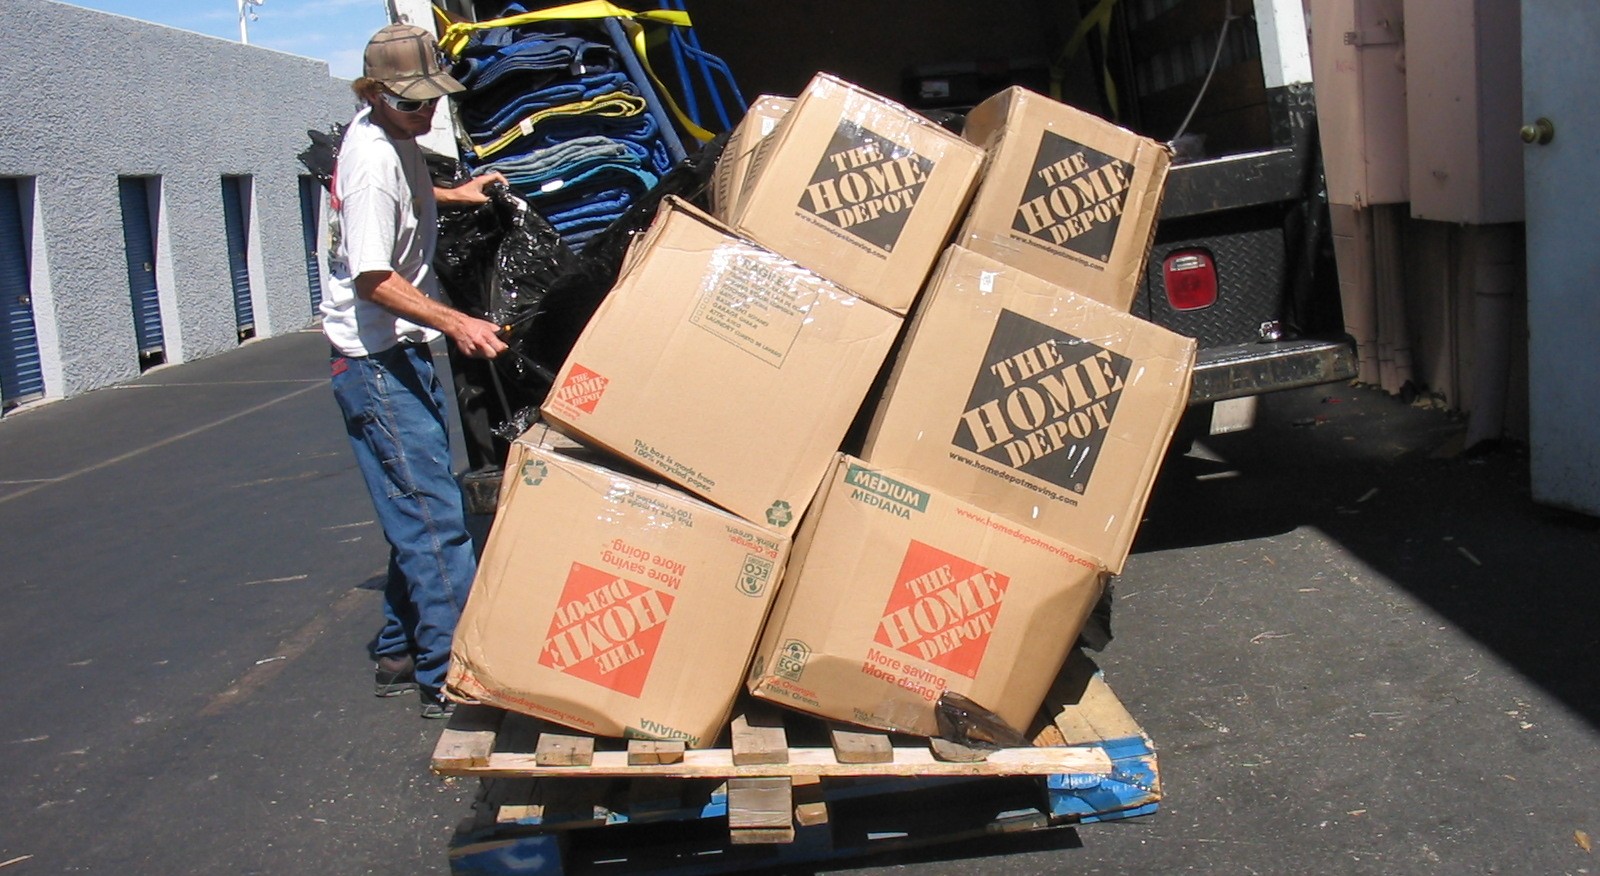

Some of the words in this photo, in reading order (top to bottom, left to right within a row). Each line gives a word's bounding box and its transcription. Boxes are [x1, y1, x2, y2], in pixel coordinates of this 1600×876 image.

[830, 142, 884, 172] THE
[1038, 151, 1089, 187] THE
[807, 154, 927, 215] HOME
[1018, 160, 1130, 234] HOME
[835, 188, 914, 229] DEPOT
[1049, 195, 1123, 246] DEPOT
[737, 256, 786, 286] RAGILE
[990, 338, 1064, 389] THE
[558, 376, 606, 401] HOME
[961, 350, 1124, 453] HOME
[1003, 400, 1110, 469] DEPOT
[633, 446, 655, 463] 100%
[634, 439, 648, 451] This
[650, 446, 665, 460] box
[666, 455, 673, 465] is
[674, 460, 695, 476] made
[853, 470, 921, 507] MEDIUM
[949, 451, 1078, 508] www.homedepotmoving.com
[851, 488, 910, 520] MEDIANA
[611, 538, 650, 562] doing.
[756, 536, 779, 551] Think
[956, 507, 1096, 571] www.homedepotmoving.com
[600, 550, 645, 574] saving.
[648, 568, 681, 590] More
[653, 555, 686, 577] More
[744, 563, 769, 579] ECO
[905, 564, 955, 599] THE
[554, 578, 632, 630] DEPOT
[881, 569, 1005, 651] HOME
[543, 589, 669, 672] HOME
[917, 611, 993, 661] DEPOT
[594, 640, 645, 676] THE
[779, 658, 801, 672] ECO
[867, 648, 904, 670] More
[903, 663, 948, 691] saving.
[862, 662, 896, 684] More
[898, 677, 937, 702] doing.
